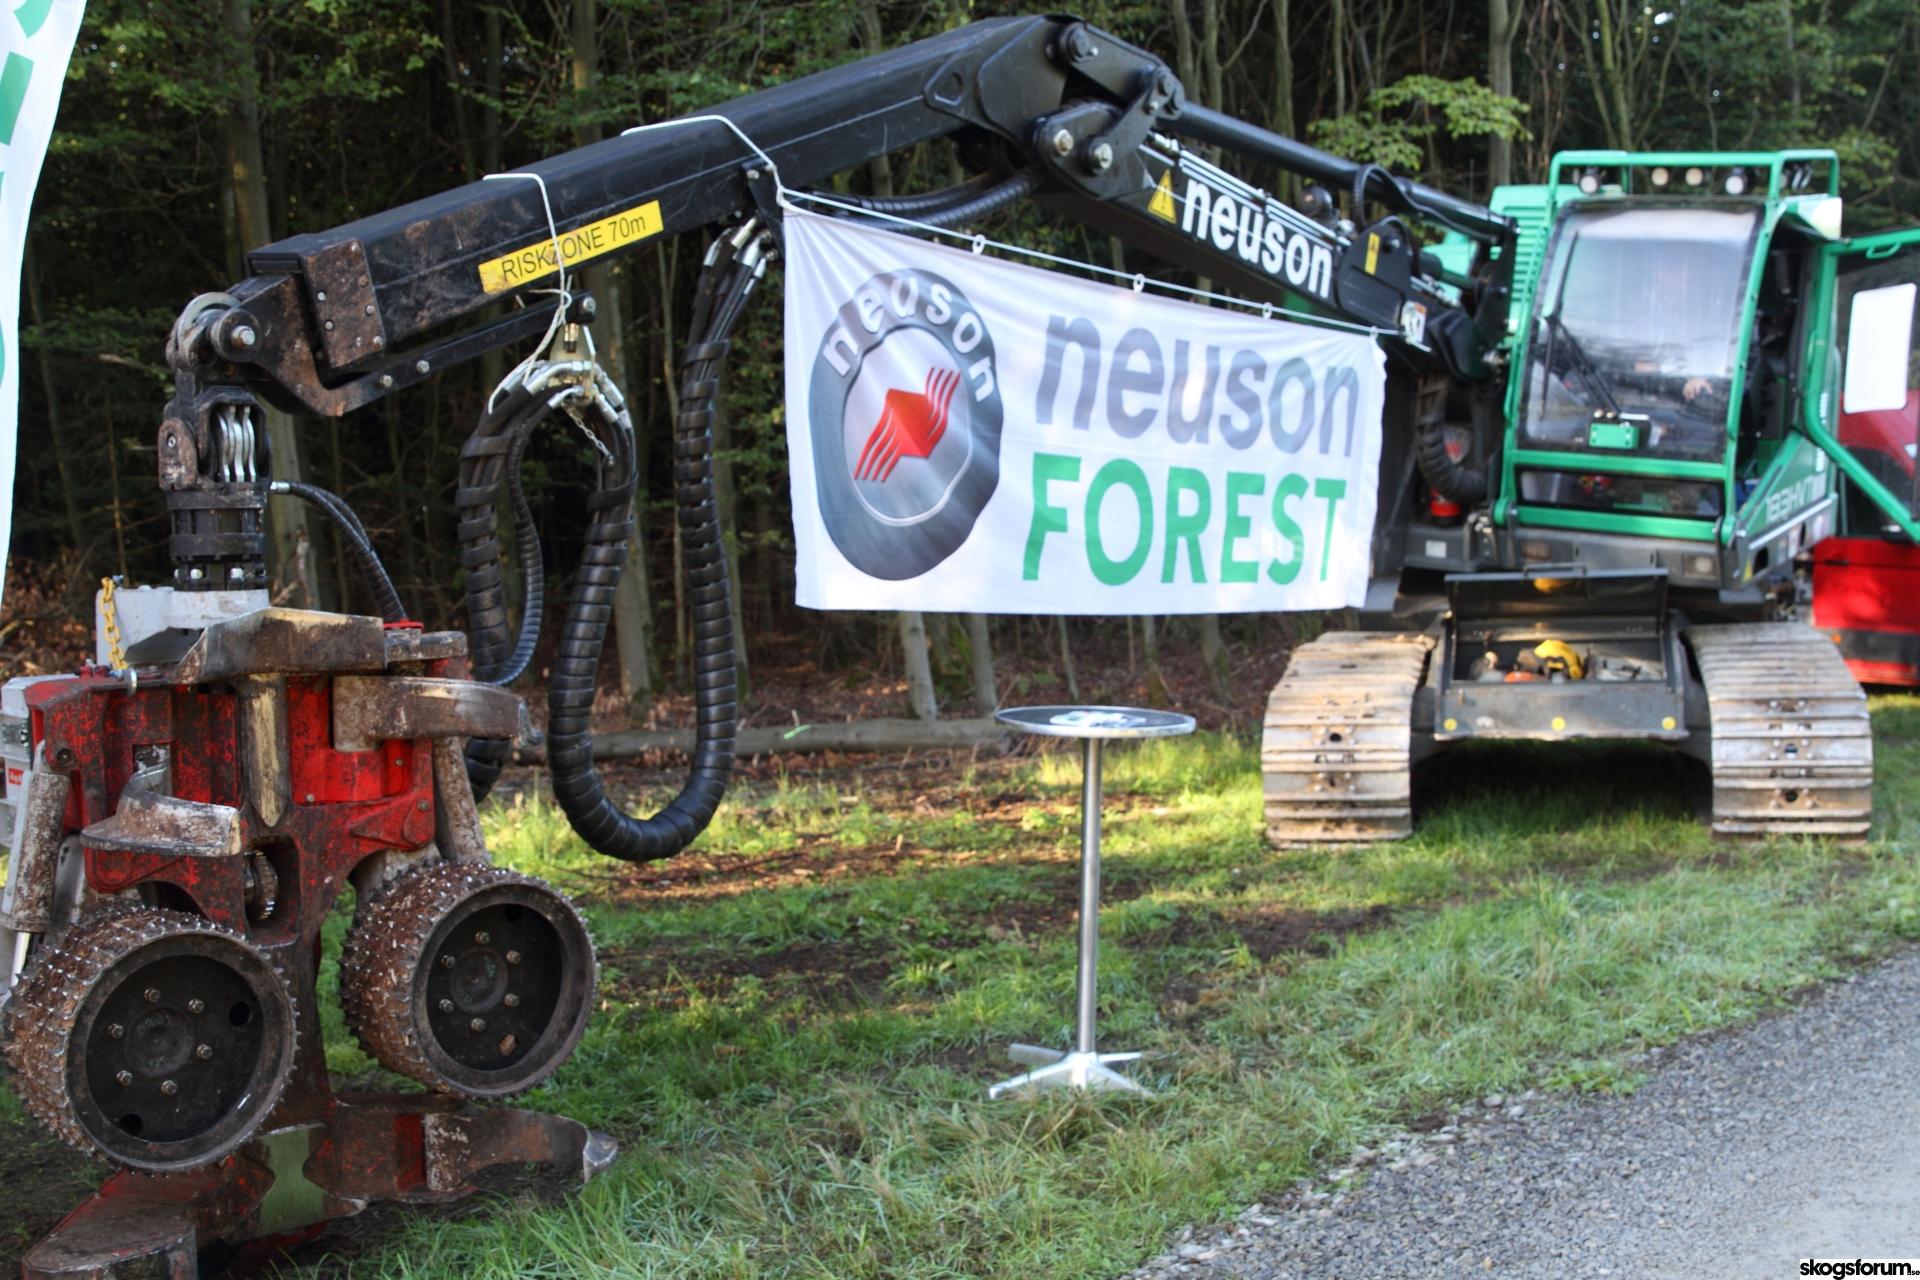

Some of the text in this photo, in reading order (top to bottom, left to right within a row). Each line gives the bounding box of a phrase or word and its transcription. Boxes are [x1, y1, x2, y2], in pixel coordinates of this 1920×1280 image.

[501, 215, 647, 282] RISKZONE 70m
[1181, 177, 1333, 299] neuson
[822, 276, 996, 403] neuson
[1035, 314, 1360, 458] neuson
[1021, 451, 1347, 586] FOREST
